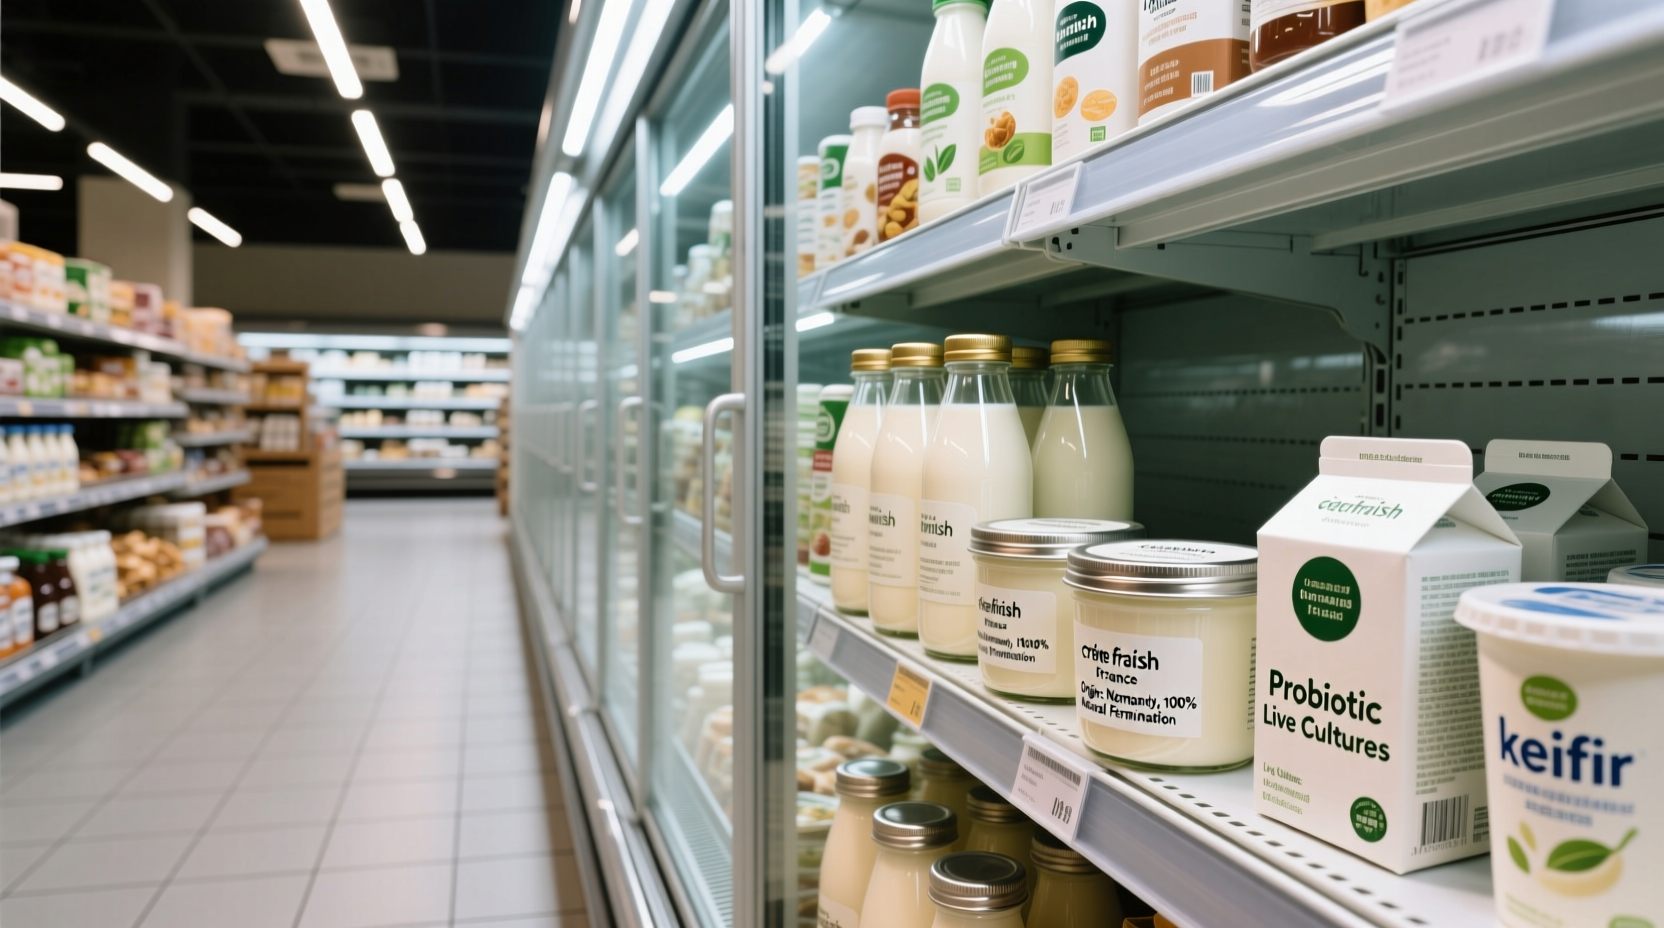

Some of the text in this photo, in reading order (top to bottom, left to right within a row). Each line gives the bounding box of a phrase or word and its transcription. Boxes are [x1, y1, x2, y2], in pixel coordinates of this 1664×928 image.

[1163, 695, 1198, 710] 100%
[1269, 668, 1383, 725] Probiotic
[1263, 703, 1391, 763] Live Cultures
[1499, 715, 1634, 788] keifir
